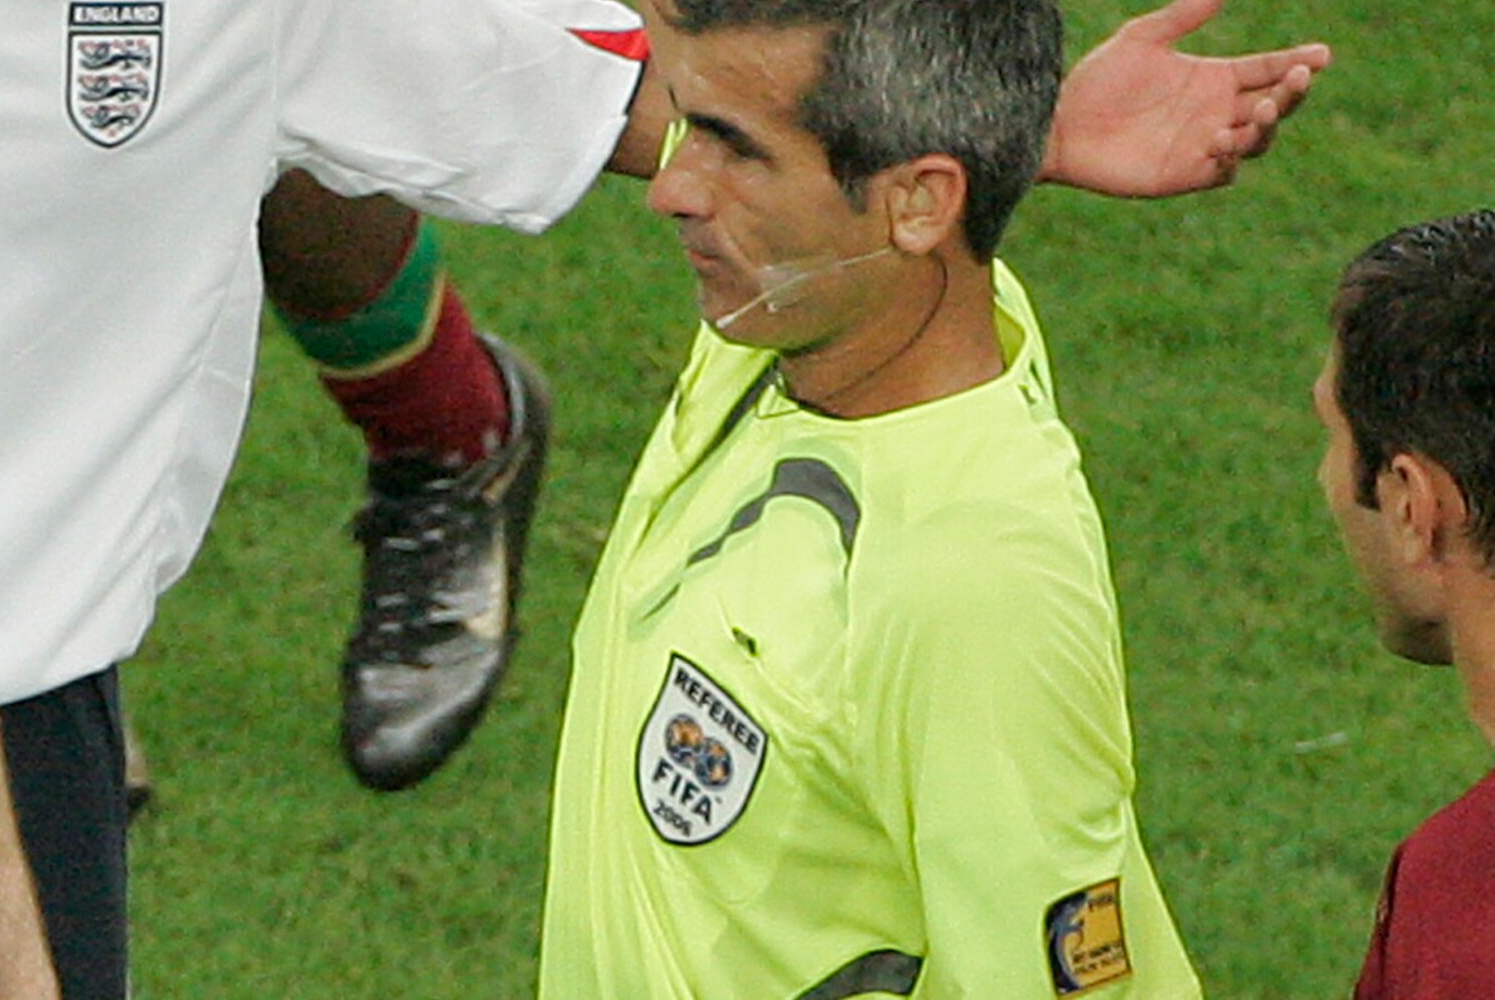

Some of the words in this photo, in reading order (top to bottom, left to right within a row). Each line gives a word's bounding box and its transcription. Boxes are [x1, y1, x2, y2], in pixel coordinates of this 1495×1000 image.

[74, 6, 160, 22] ENGLAND
[673, 667, 761, 755] REFEREE
[652, 757, 713, 826] FIFA
[653, 800, 693, 838] 2006
